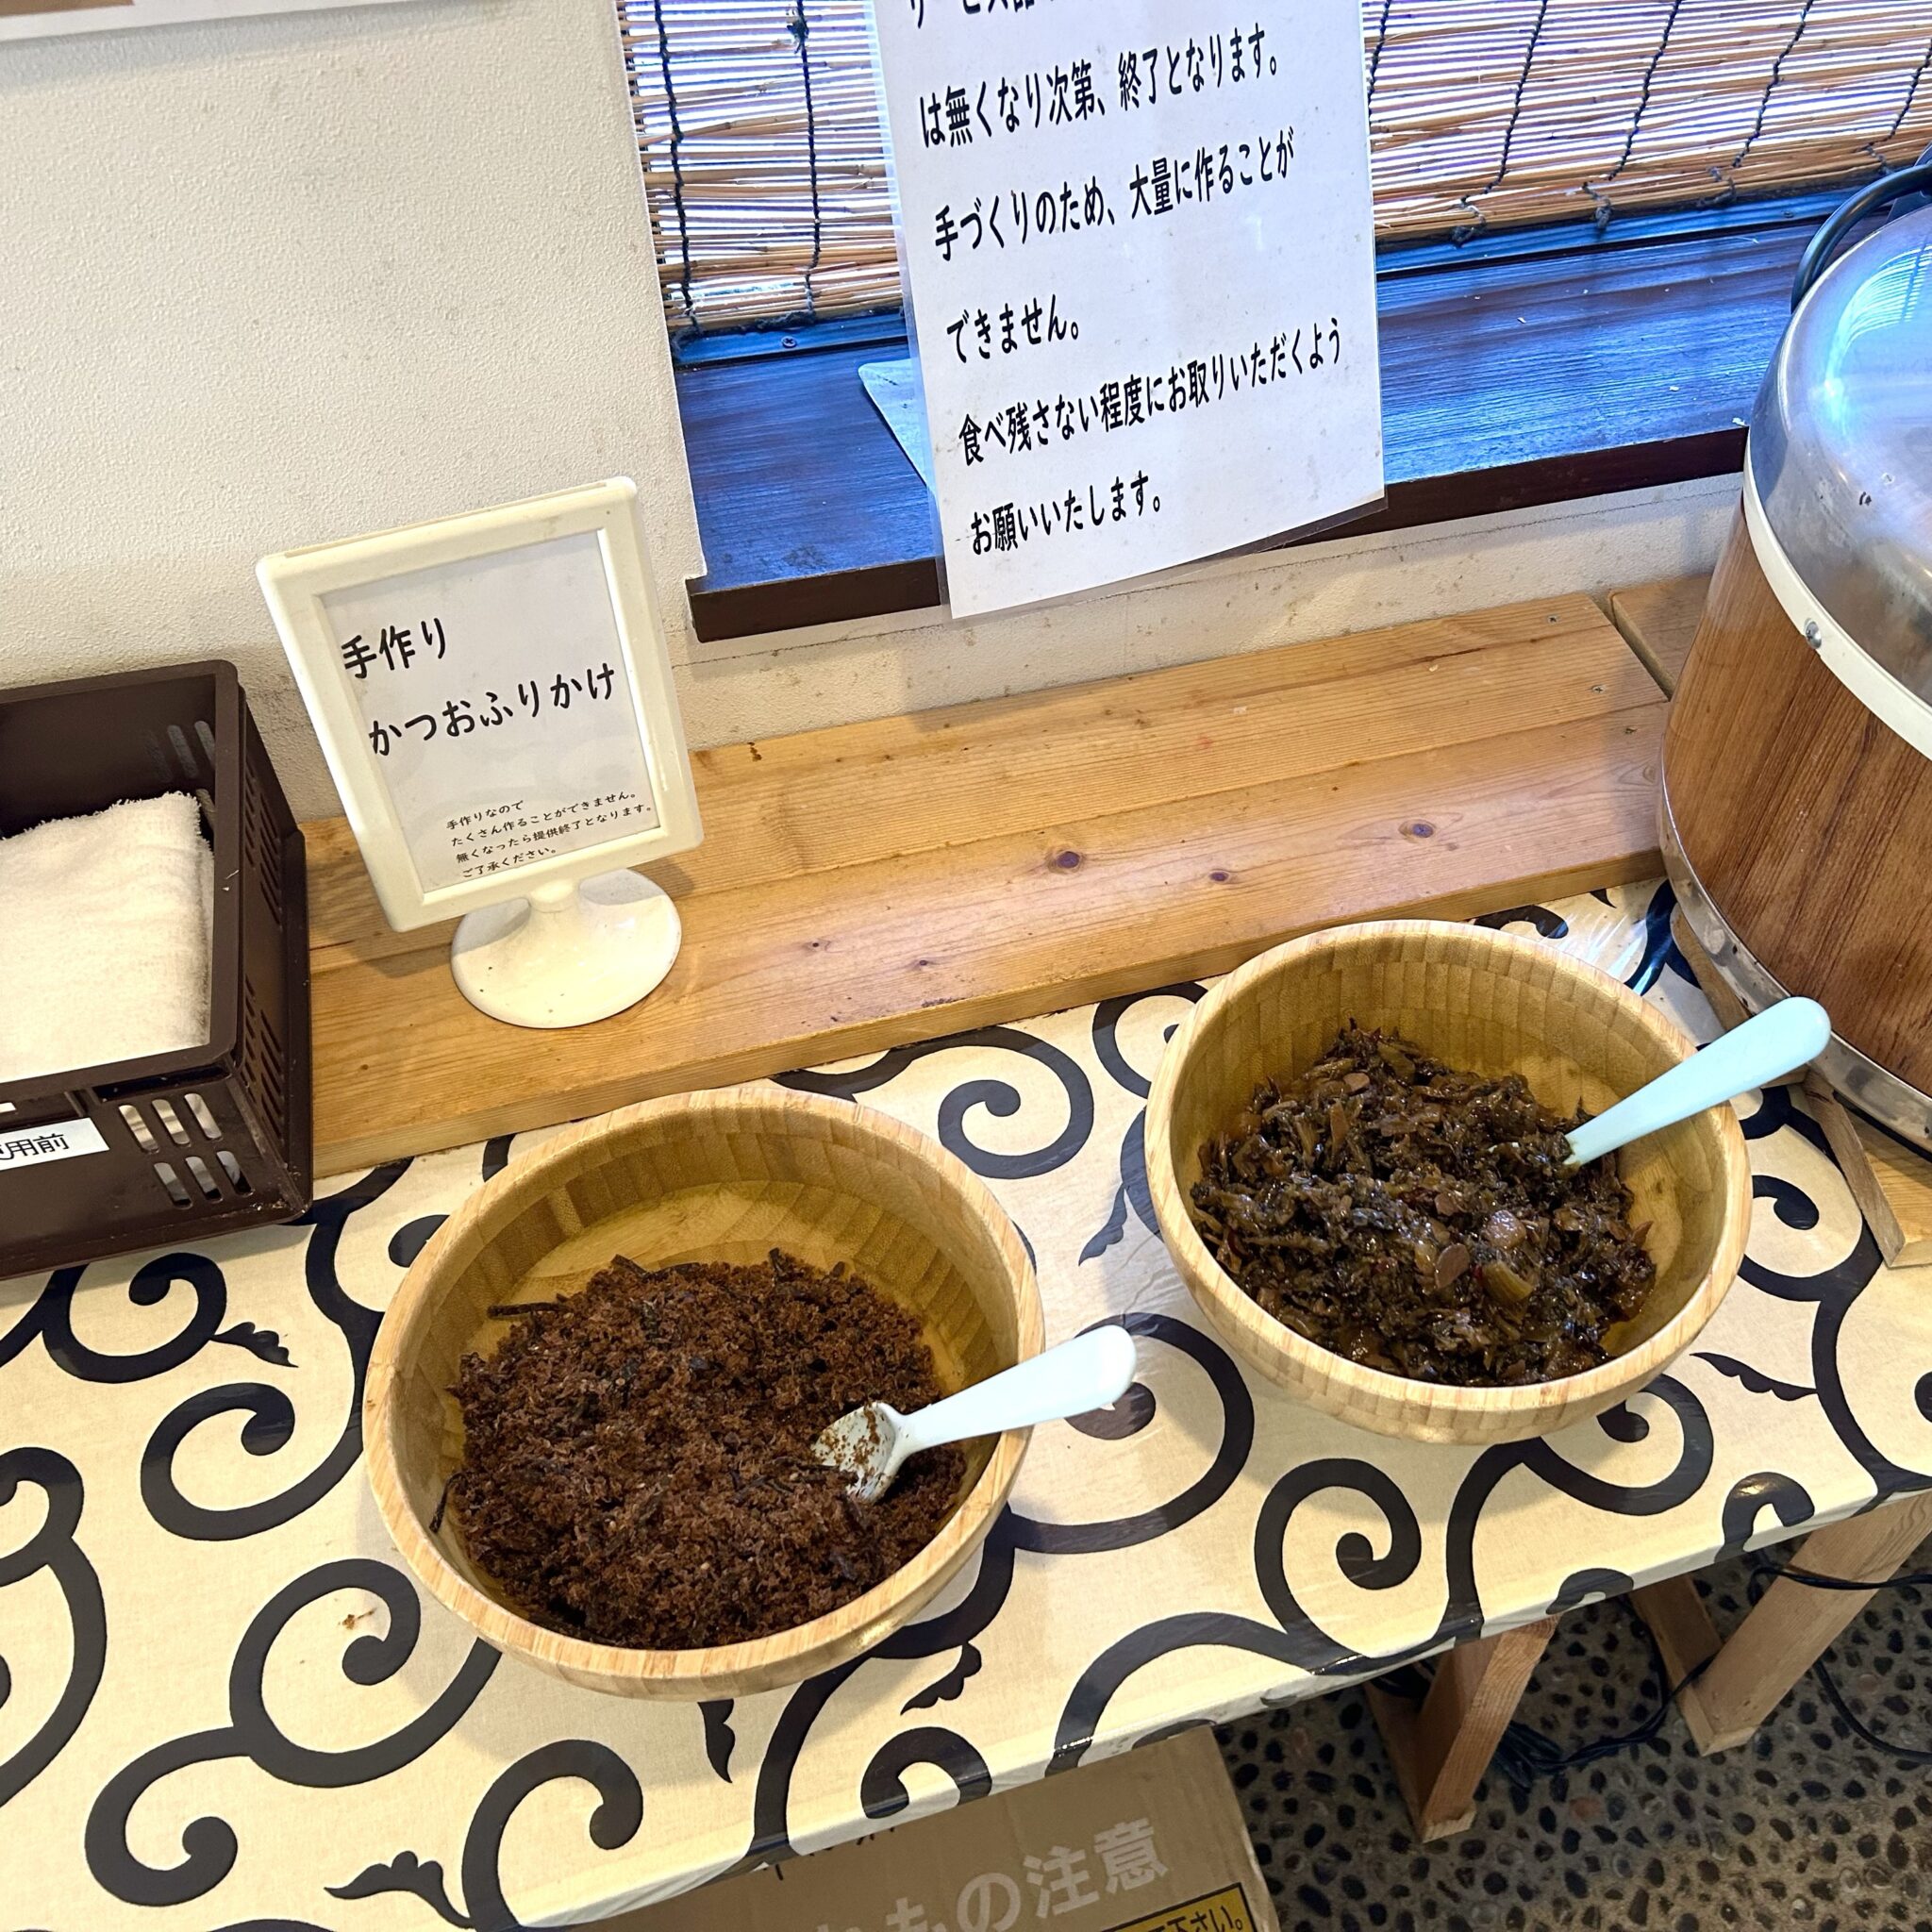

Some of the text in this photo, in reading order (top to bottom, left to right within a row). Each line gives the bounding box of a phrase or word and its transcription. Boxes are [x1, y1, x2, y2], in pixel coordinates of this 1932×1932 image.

[921, 24, 1277, 147] は無くなり次第、終了となります。
[935, 127, 1294, 261] 手づくりのため、大量に作ることが
[947, 294, 1079, 364] できません。
[958, 318, 1341, 467] 食べ残さない程度にお取りいただくよう
[971, 471, 1160, 556] お願いいたします。
[341, 618, 446, 679] 手作り
[368, 663, 615, 757] かつおふりかけ
[446, 800, 524, 830] 手作りなので
[451, 791, 636, 847] たくさん作ることができません。
[457, 804, 651, 863] 無くなったら提供終了となります。
[462, 847, 556, 878] ご了承ください。
[817, 1817, 1168, 1932] もの注意
